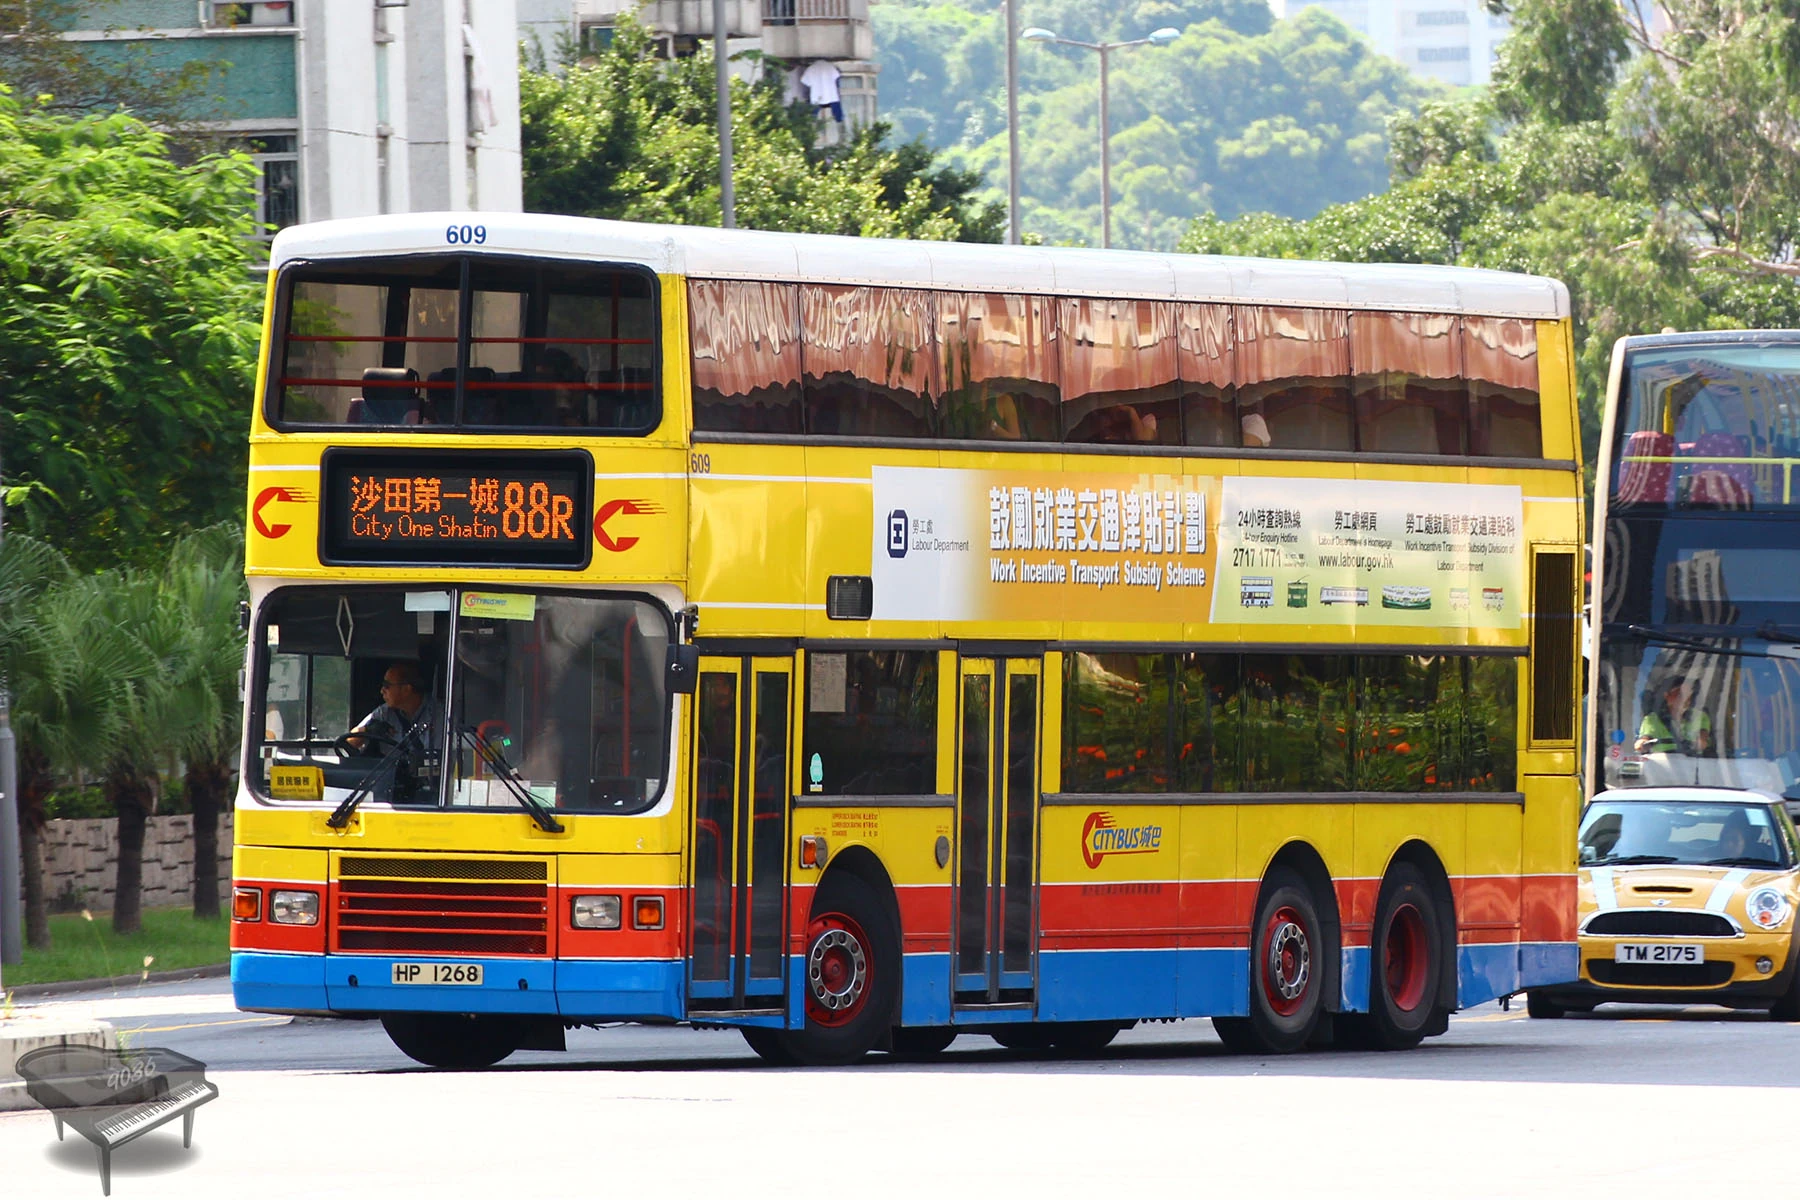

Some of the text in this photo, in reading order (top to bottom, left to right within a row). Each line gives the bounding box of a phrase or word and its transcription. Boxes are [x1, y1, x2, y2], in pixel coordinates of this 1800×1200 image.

[446, 224, 487, 245] 609
[691, 453, 710, 473] 609
[351, 476, 499, 514] 沙田第一城
[502, 481, 575, 540] 88R
[989, 486, 1207, 554] 鼓勵就業交通津貼計劃
[352, 513, 498, 541] City One Shatin
[912, 537, 969, 555] Labour Department
[1260, 532, 1280, 545] Enquiry
[1280, 532, 1298, 543] Hotline
[1318, 535, 1334, 546] Labour
[1404, 540, 1418, 552] Work
[1488, 543, 1508, 554] Division
[1233, 548, 1282, 568] 2717 1771
[1318, 552, 1394, 572] www.labour.gov.hk
[990, 558, 1206, 592] Work Incentive Transport Subsidy Scheme
[1093, 827, 1141, 850] CITYBUS
[1140, 825, 1162, 848] 城巴
[1623, 945, 1697, 962] TM 2175
[396, 964, 479, 983] HP 1268
